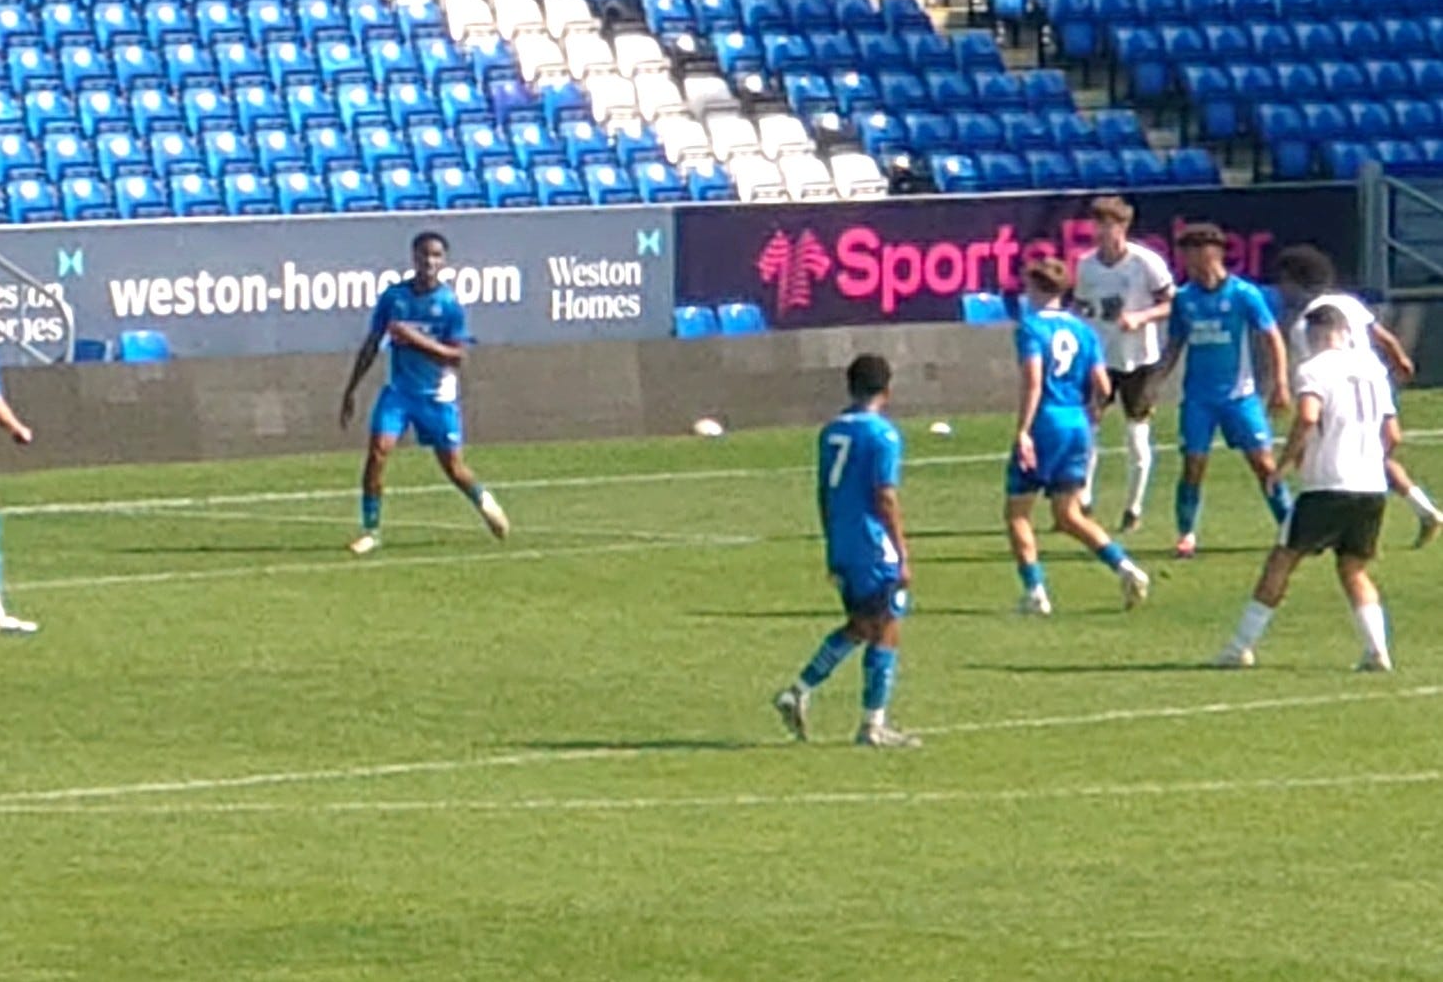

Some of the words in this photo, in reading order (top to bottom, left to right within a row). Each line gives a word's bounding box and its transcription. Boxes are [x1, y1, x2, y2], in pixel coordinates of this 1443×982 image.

[548, 256, 641, 287] Weston
[552, 289, 641, 321] Homes
[1051, 329, 1079, 379] 9
[1347, 375, 1377, 424] 11
[827, 433, 852, 487] 7
